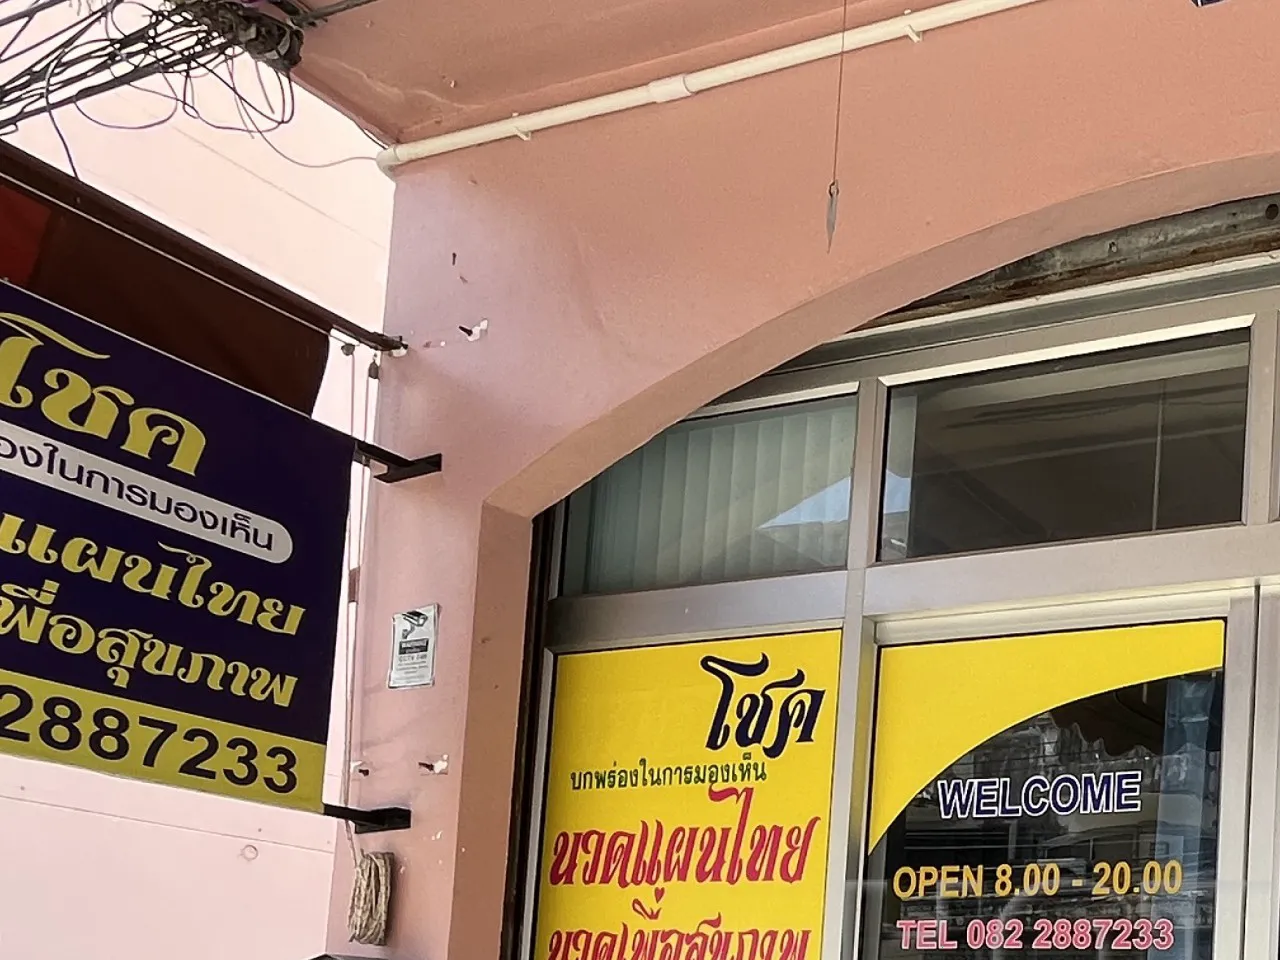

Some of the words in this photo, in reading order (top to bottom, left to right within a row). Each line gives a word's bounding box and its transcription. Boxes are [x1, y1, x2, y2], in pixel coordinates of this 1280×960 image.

[0, 512, 306, 636] แผนไทย
[0, 685, 298, 795] 2887233
[700, 652, 825, 758] โชค
[570, 752, 767, 790] บกพร่องในการมองเห็น
[937, 771, 1142, 819] WELCOME
[549, 785, 821, 889] นวดแผนไทย
[892, 864, 984, 901] OPEN
[994, 862, 1061, 897] 8.00
[1092, 859, 1183, 896] 20.00
[896, 919, 958, 950] TEL
[967, 918, 1024, 950] 082
[1032, 918, 1174, 950] 2887233
